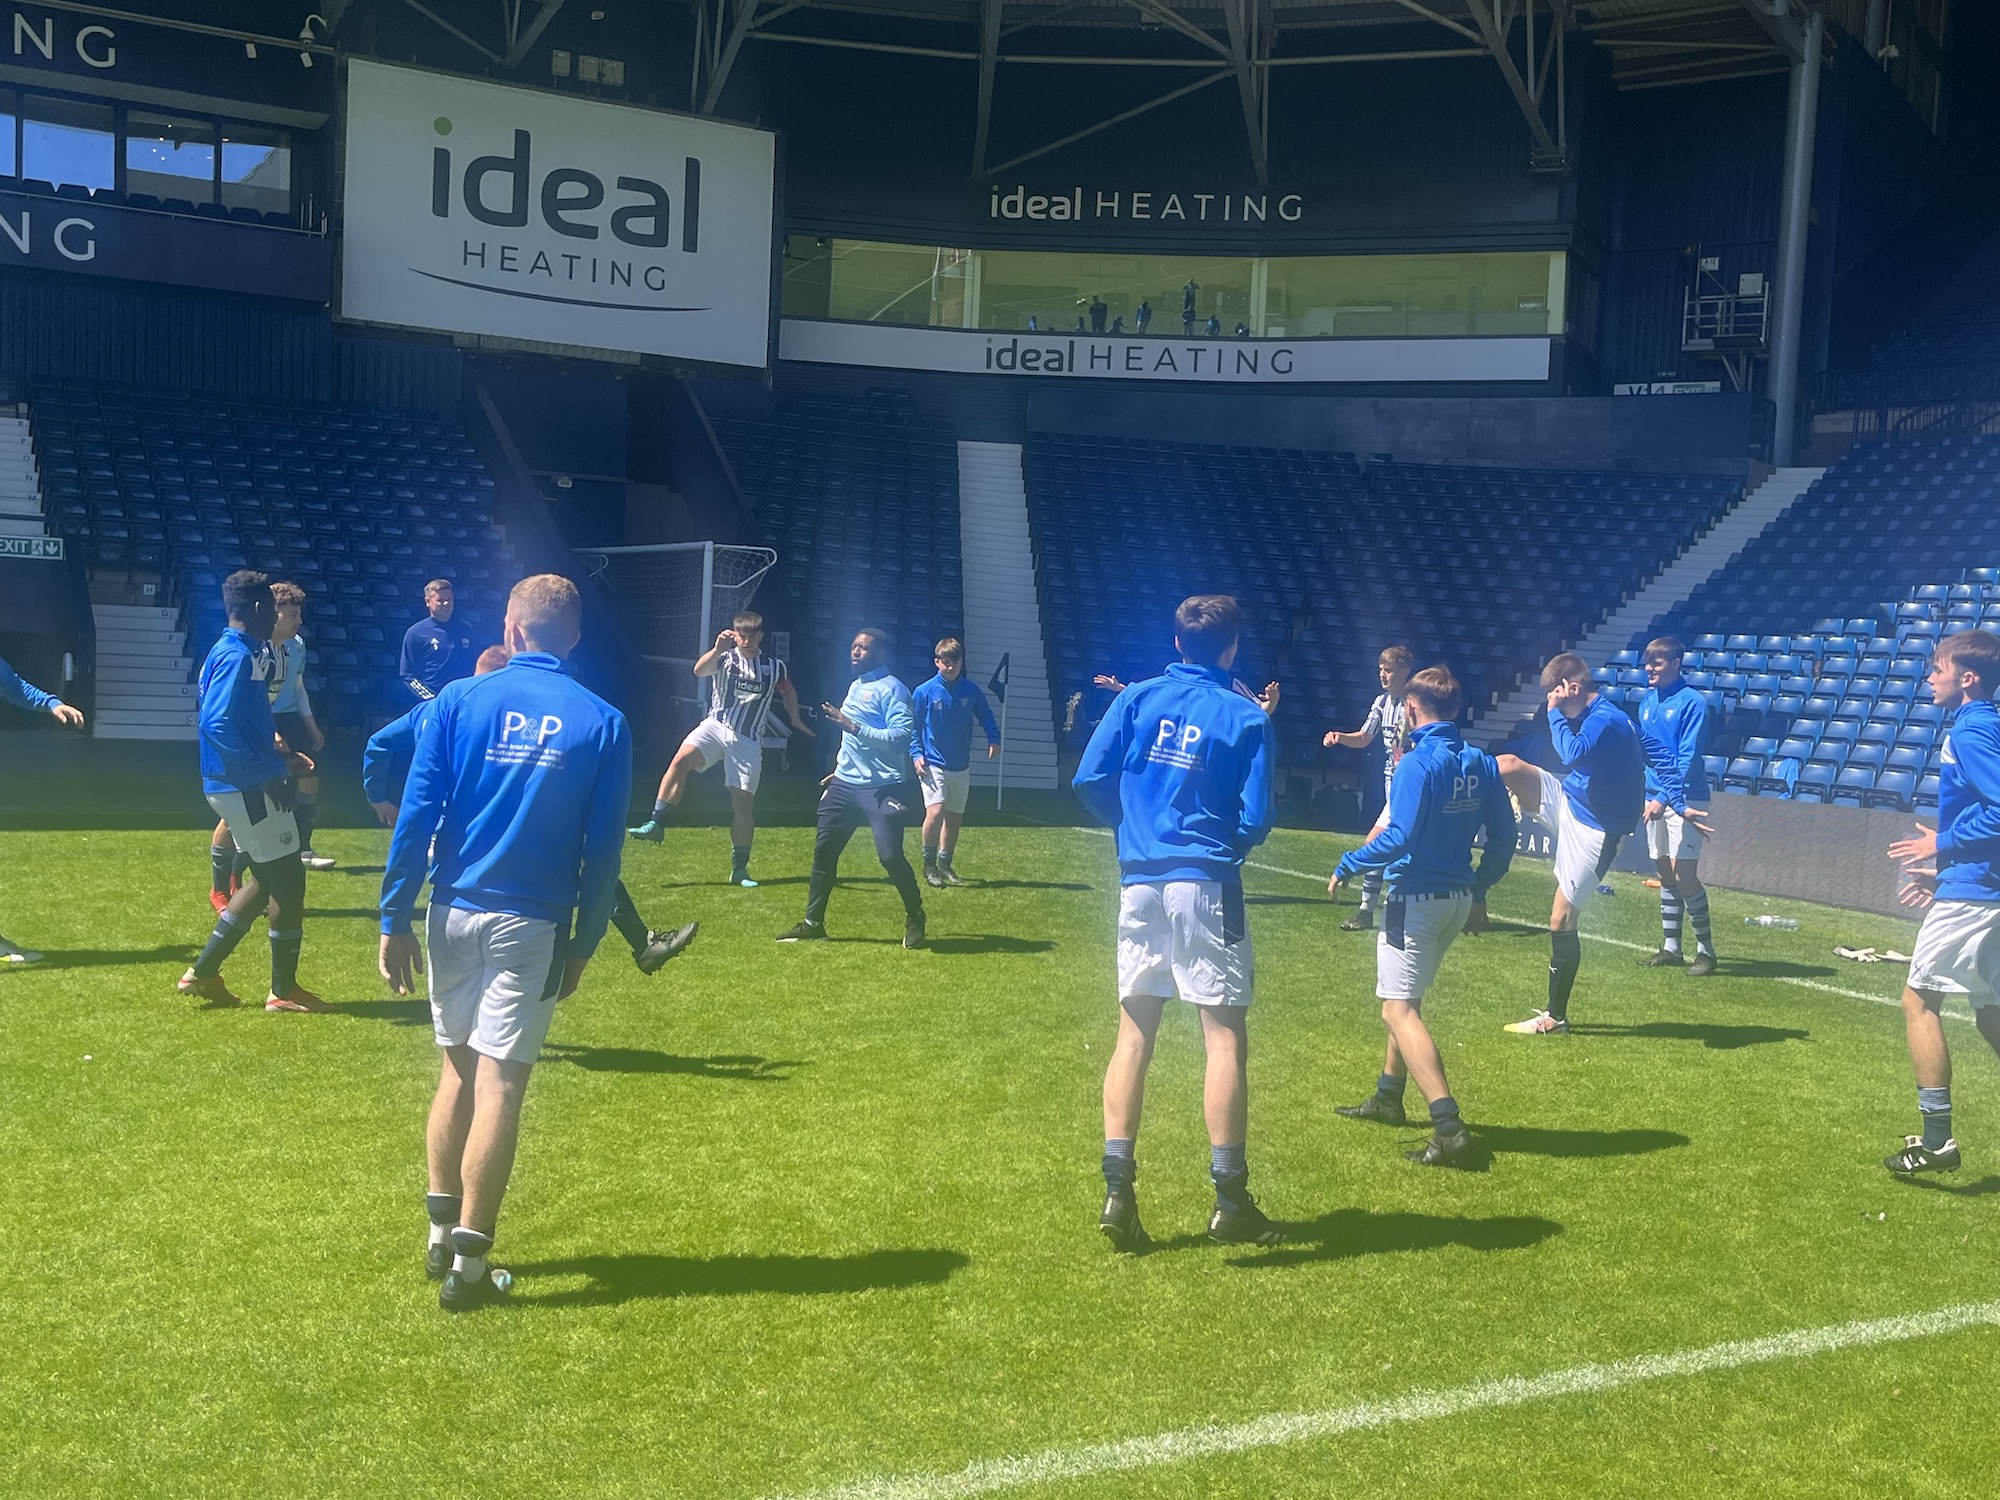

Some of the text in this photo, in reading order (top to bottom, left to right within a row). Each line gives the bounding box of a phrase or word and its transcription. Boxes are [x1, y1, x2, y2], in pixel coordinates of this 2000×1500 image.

[13, 13, 118, 69] NG
[432, 116, 701, 254] ideal
[990, 184, 1303, 222] ideal HEATING
[461, 240, 669, 292] HEATING
[986, 337, 1295, 375] ideal HEATING
[145, 586, 154, 595] H
[161, 609, 169, 618] G
[168, 635, 175, 643] F
[174, 660, 180, 668] E
[181, 687, 189, 695] D
[737, 680, 762, 693] ideal
[186, 715, 194, 723] C
[503, 711, 562, 745] P&P
[1452, 774, 1479, 800] PP
